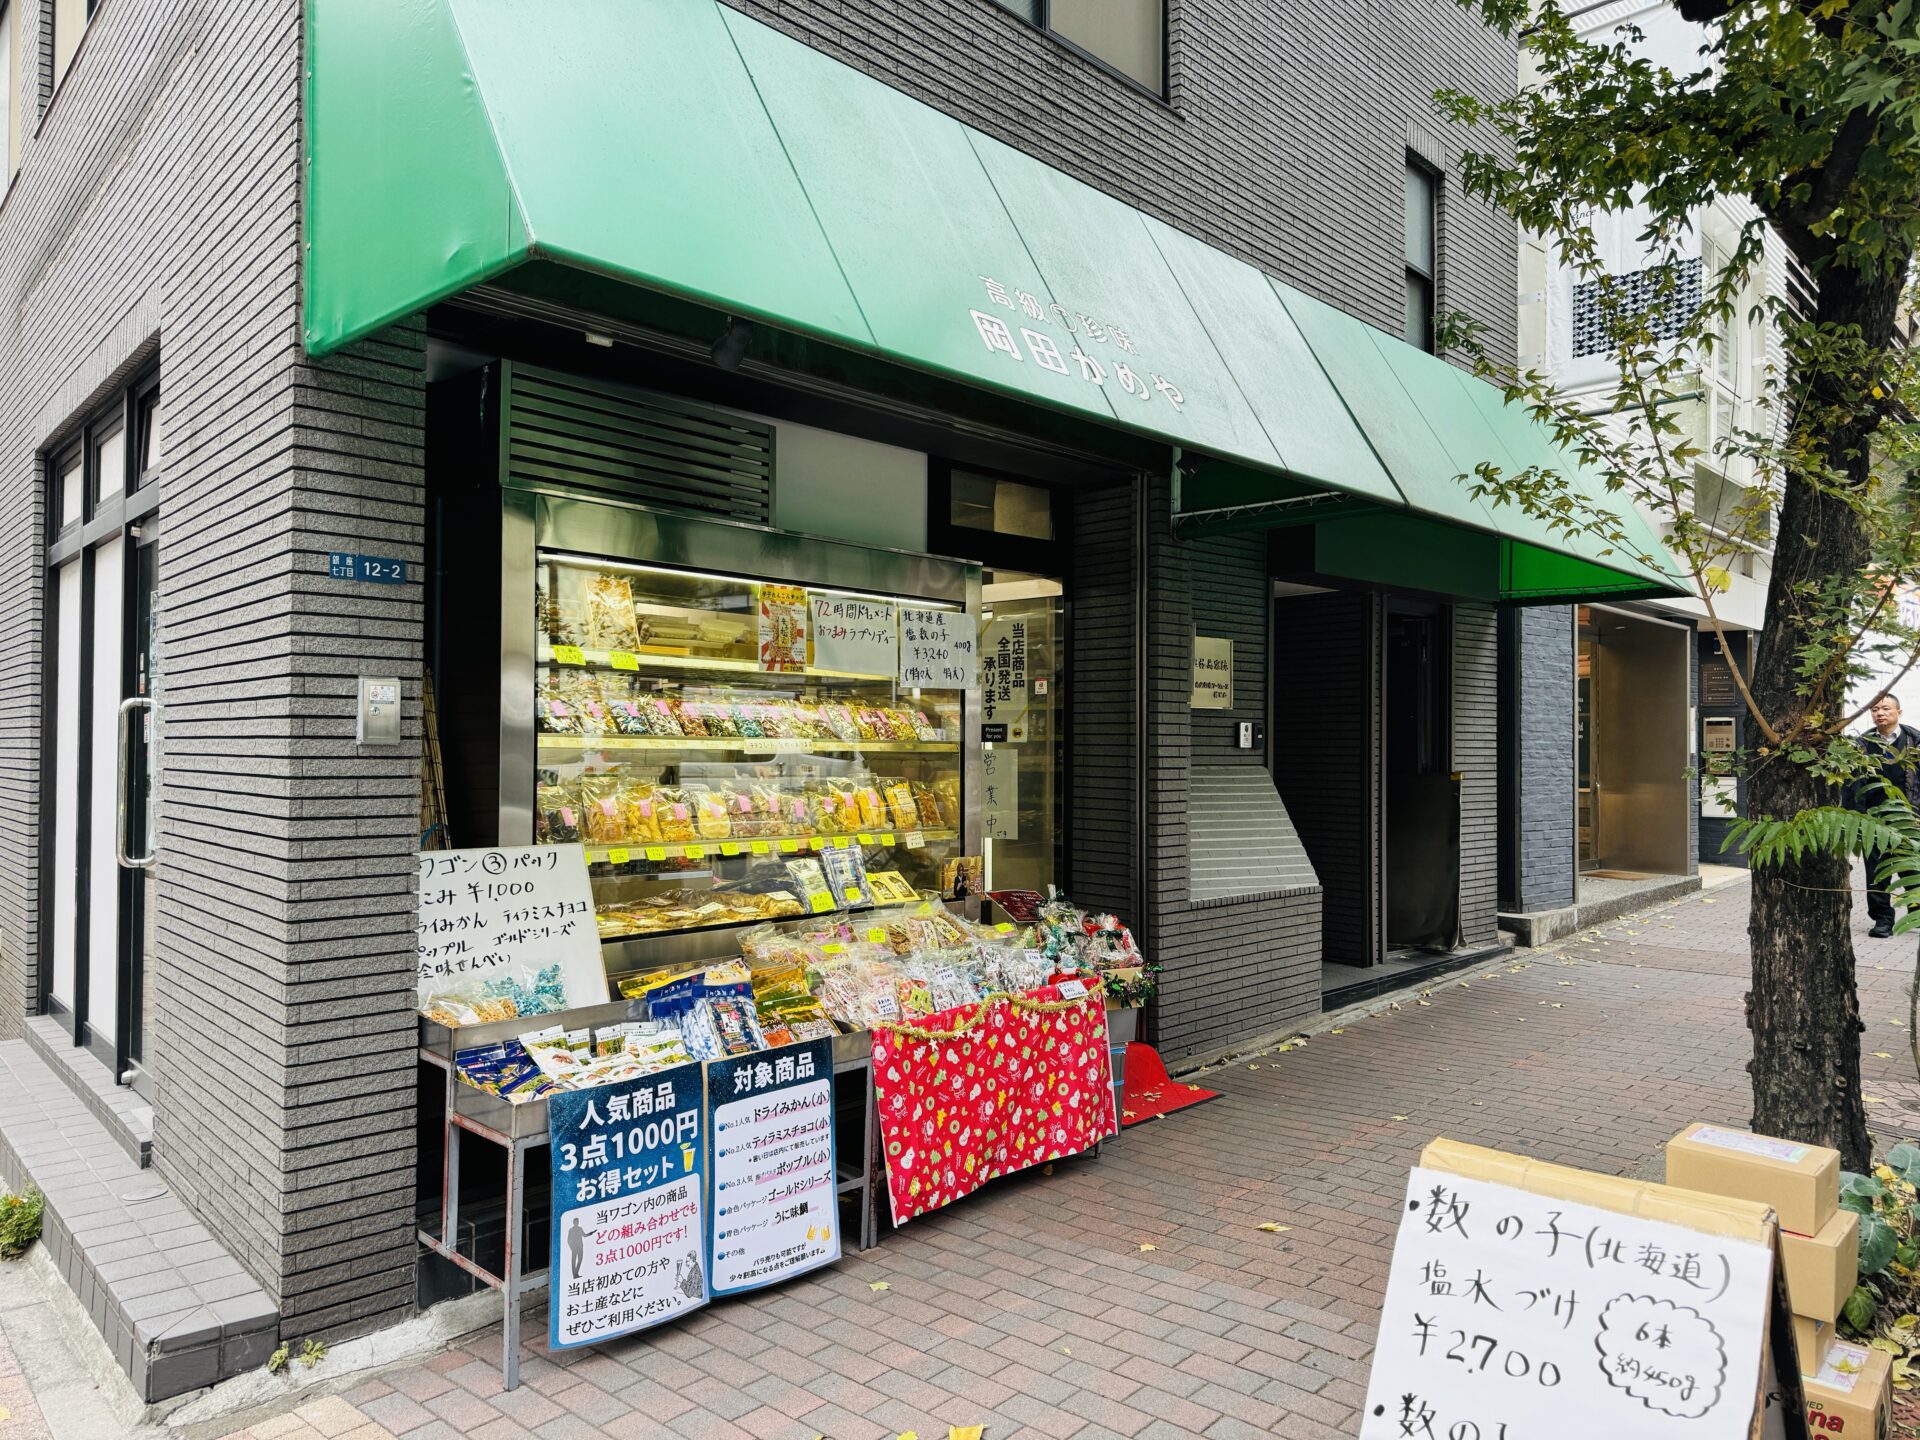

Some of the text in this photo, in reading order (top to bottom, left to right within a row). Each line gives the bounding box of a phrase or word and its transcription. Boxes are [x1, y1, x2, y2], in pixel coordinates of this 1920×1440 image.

[969, 308, 1185, 413] 岡田かめや
[332, 555, 354, 566] 銀座
[332, 566, 354, 578] 七丁目
[364, 562, 401, 578] 12-2
[903, 610, 946, 626] 北海道産
[997, 636, 1011, 701] 全国発送
[1012, 622, 1025, 689] 当店商品
[983, 656, 997, 720] 承ります
[503, 901, 588, 924] ティラミスチョコ
[492, 920, 577, 947] ゴールドシリーズ
[734, 1051, 815, 1095] 対象商品
[579, 1081, 676, 1130] 人気商品
[754, 1089, 830, 1123] ドライみかん(小)
[560, 1108, 698, 1172] 3点1000円
[752, 1115, 831, 1149] ティラミスチョコ(小)
[576, 1155, 675, 1202] お得セット
[768, 1170, 832, 1202] ゴールドシリーズ
[595, 1201, 698, 1245] どの組み合わせでも
[596, 1184, 688, 1226] 当ワゴン内の商品
[595, 1225, 688, 1266] 3点1000円です!
[725, 1247, 746, 1259] その他
[567, 1257, 670, 1298] 当店初めての方や
[1418, 1259, 1580, 1329] 塩水づけ
[566, 1286, 644, 1318] お土産などに
[566, 1296, 682, 1336] ぜひご利用ください。
[1635, 1322, 1673, 1349] 6本
[1615, 1353, 1701, 1401] 約450g
